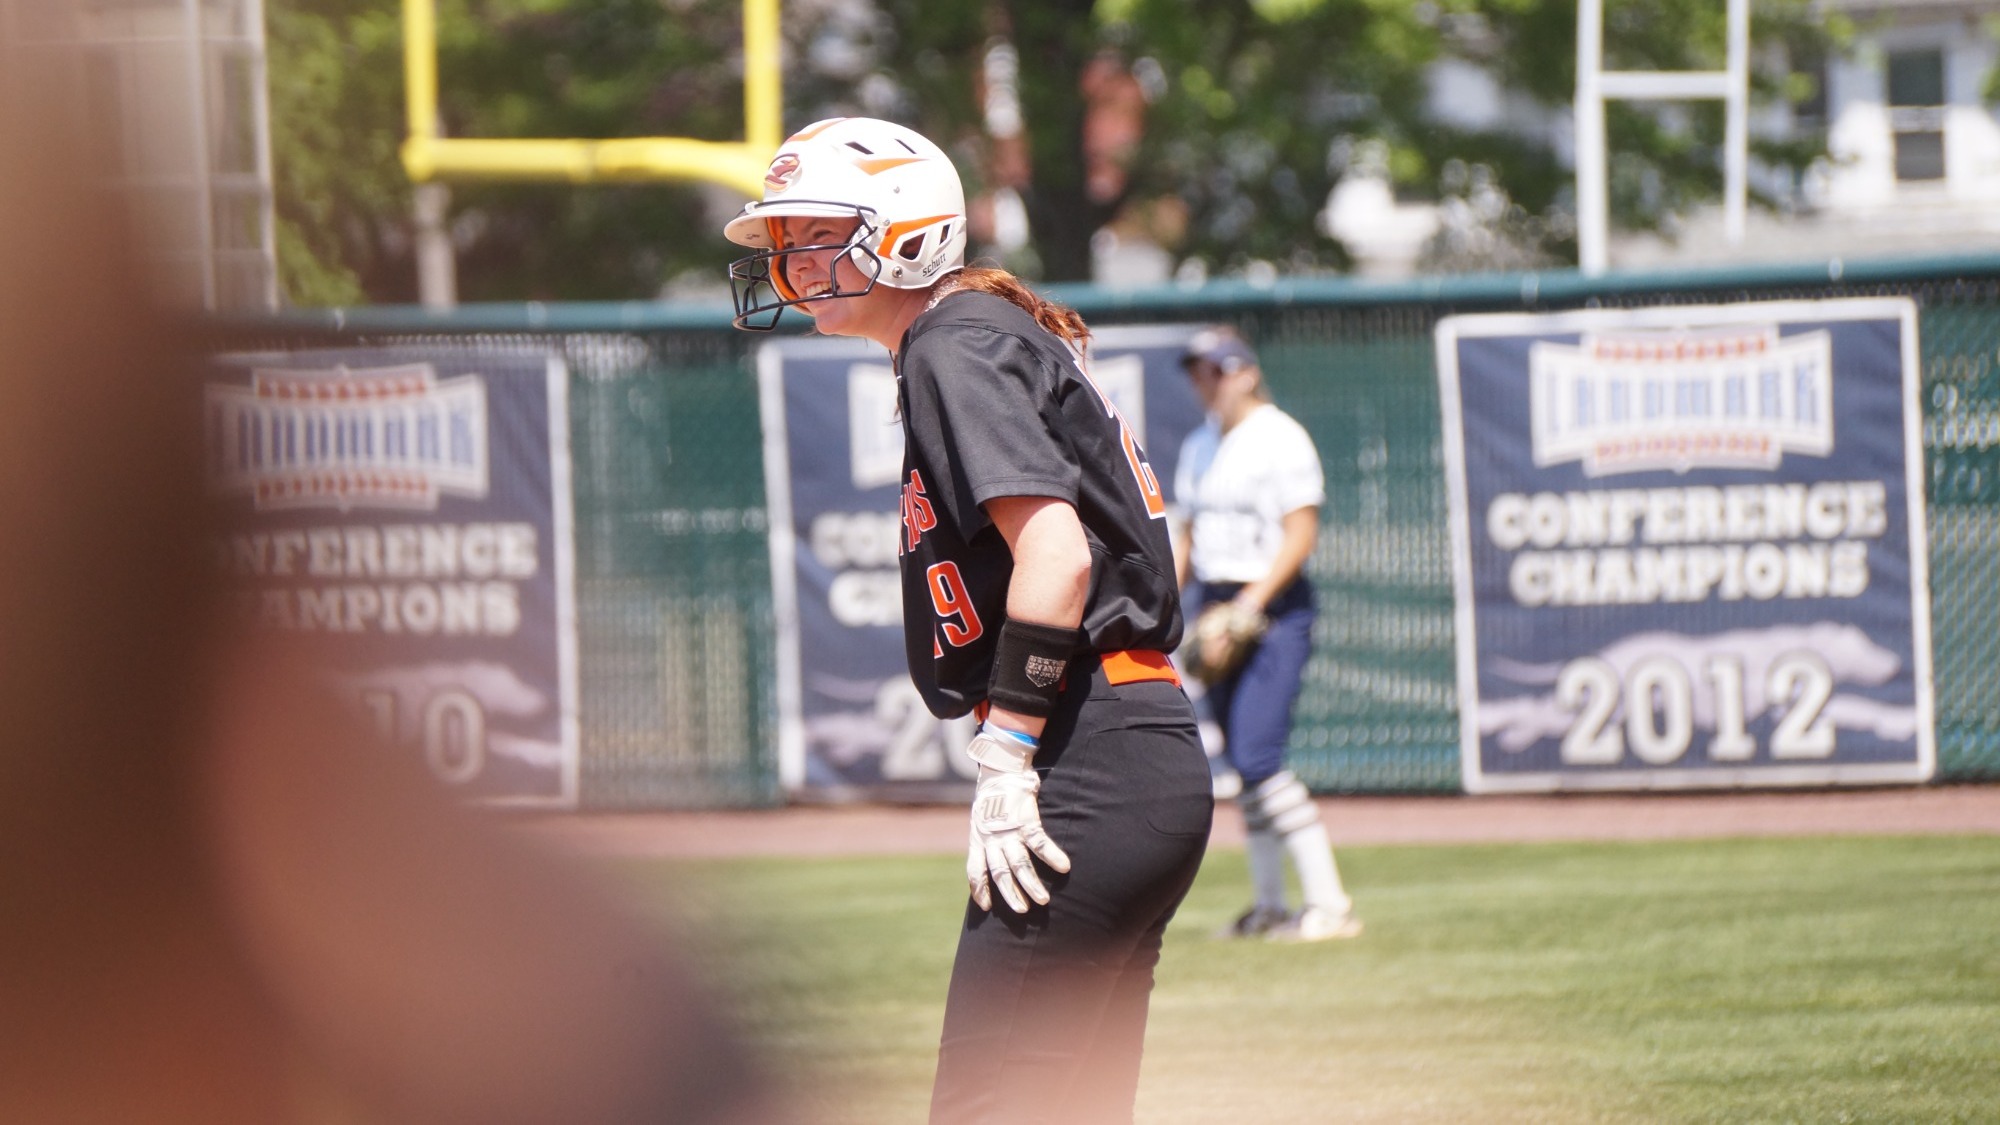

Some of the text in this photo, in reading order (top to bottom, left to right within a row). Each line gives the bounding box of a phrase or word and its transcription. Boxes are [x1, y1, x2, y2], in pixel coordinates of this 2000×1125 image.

[1487, 481, 1887, 550] CONFERENCE
[231, 523, 538, 579] NFERENCE
[1510, 541, 1869, 606] CHAMPIONS
[261, 581, 521, 636] AMPIONS
[927, 561, 984, 659] 9
[1556, 648, 1836, 765] 2012
